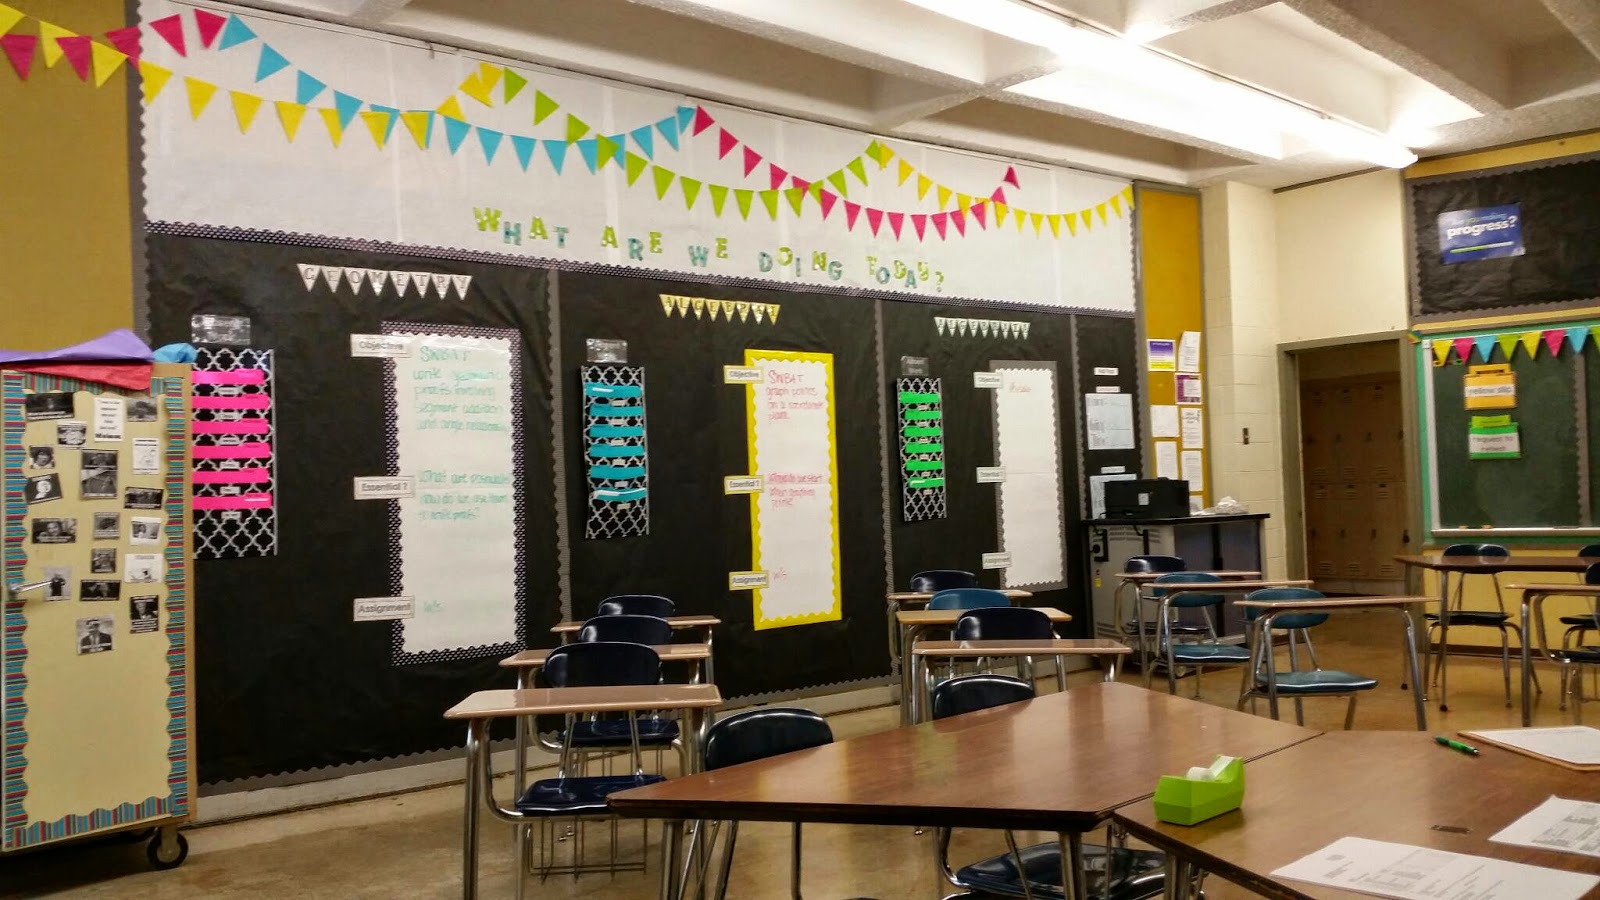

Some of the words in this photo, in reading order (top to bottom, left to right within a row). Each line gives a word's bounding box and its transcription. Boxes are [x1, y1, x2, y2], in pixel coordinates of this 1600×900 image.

[1446, 215, 1519, 241] progress?
[473, 207, 568, 248] WHAT
[602, 225, 662, 261] ARE
[688, 237, 728, 267] WE
[758, 246, 843, 281] DOING
[865, 255, 945, 292] TODAY?
[302, 266, 471, 293] GEOMETRY
[359, 340, 404, 351] Objective
[729, 370, 759, 379] Objective
[768, 369, 804, 384] SWBAT
[361, 482, 400, 492] Essential
[729, 480, 755, 488] Essential
[733, 576, 767, 584] Assignment
[358, 602, 412, 614] Assignment
